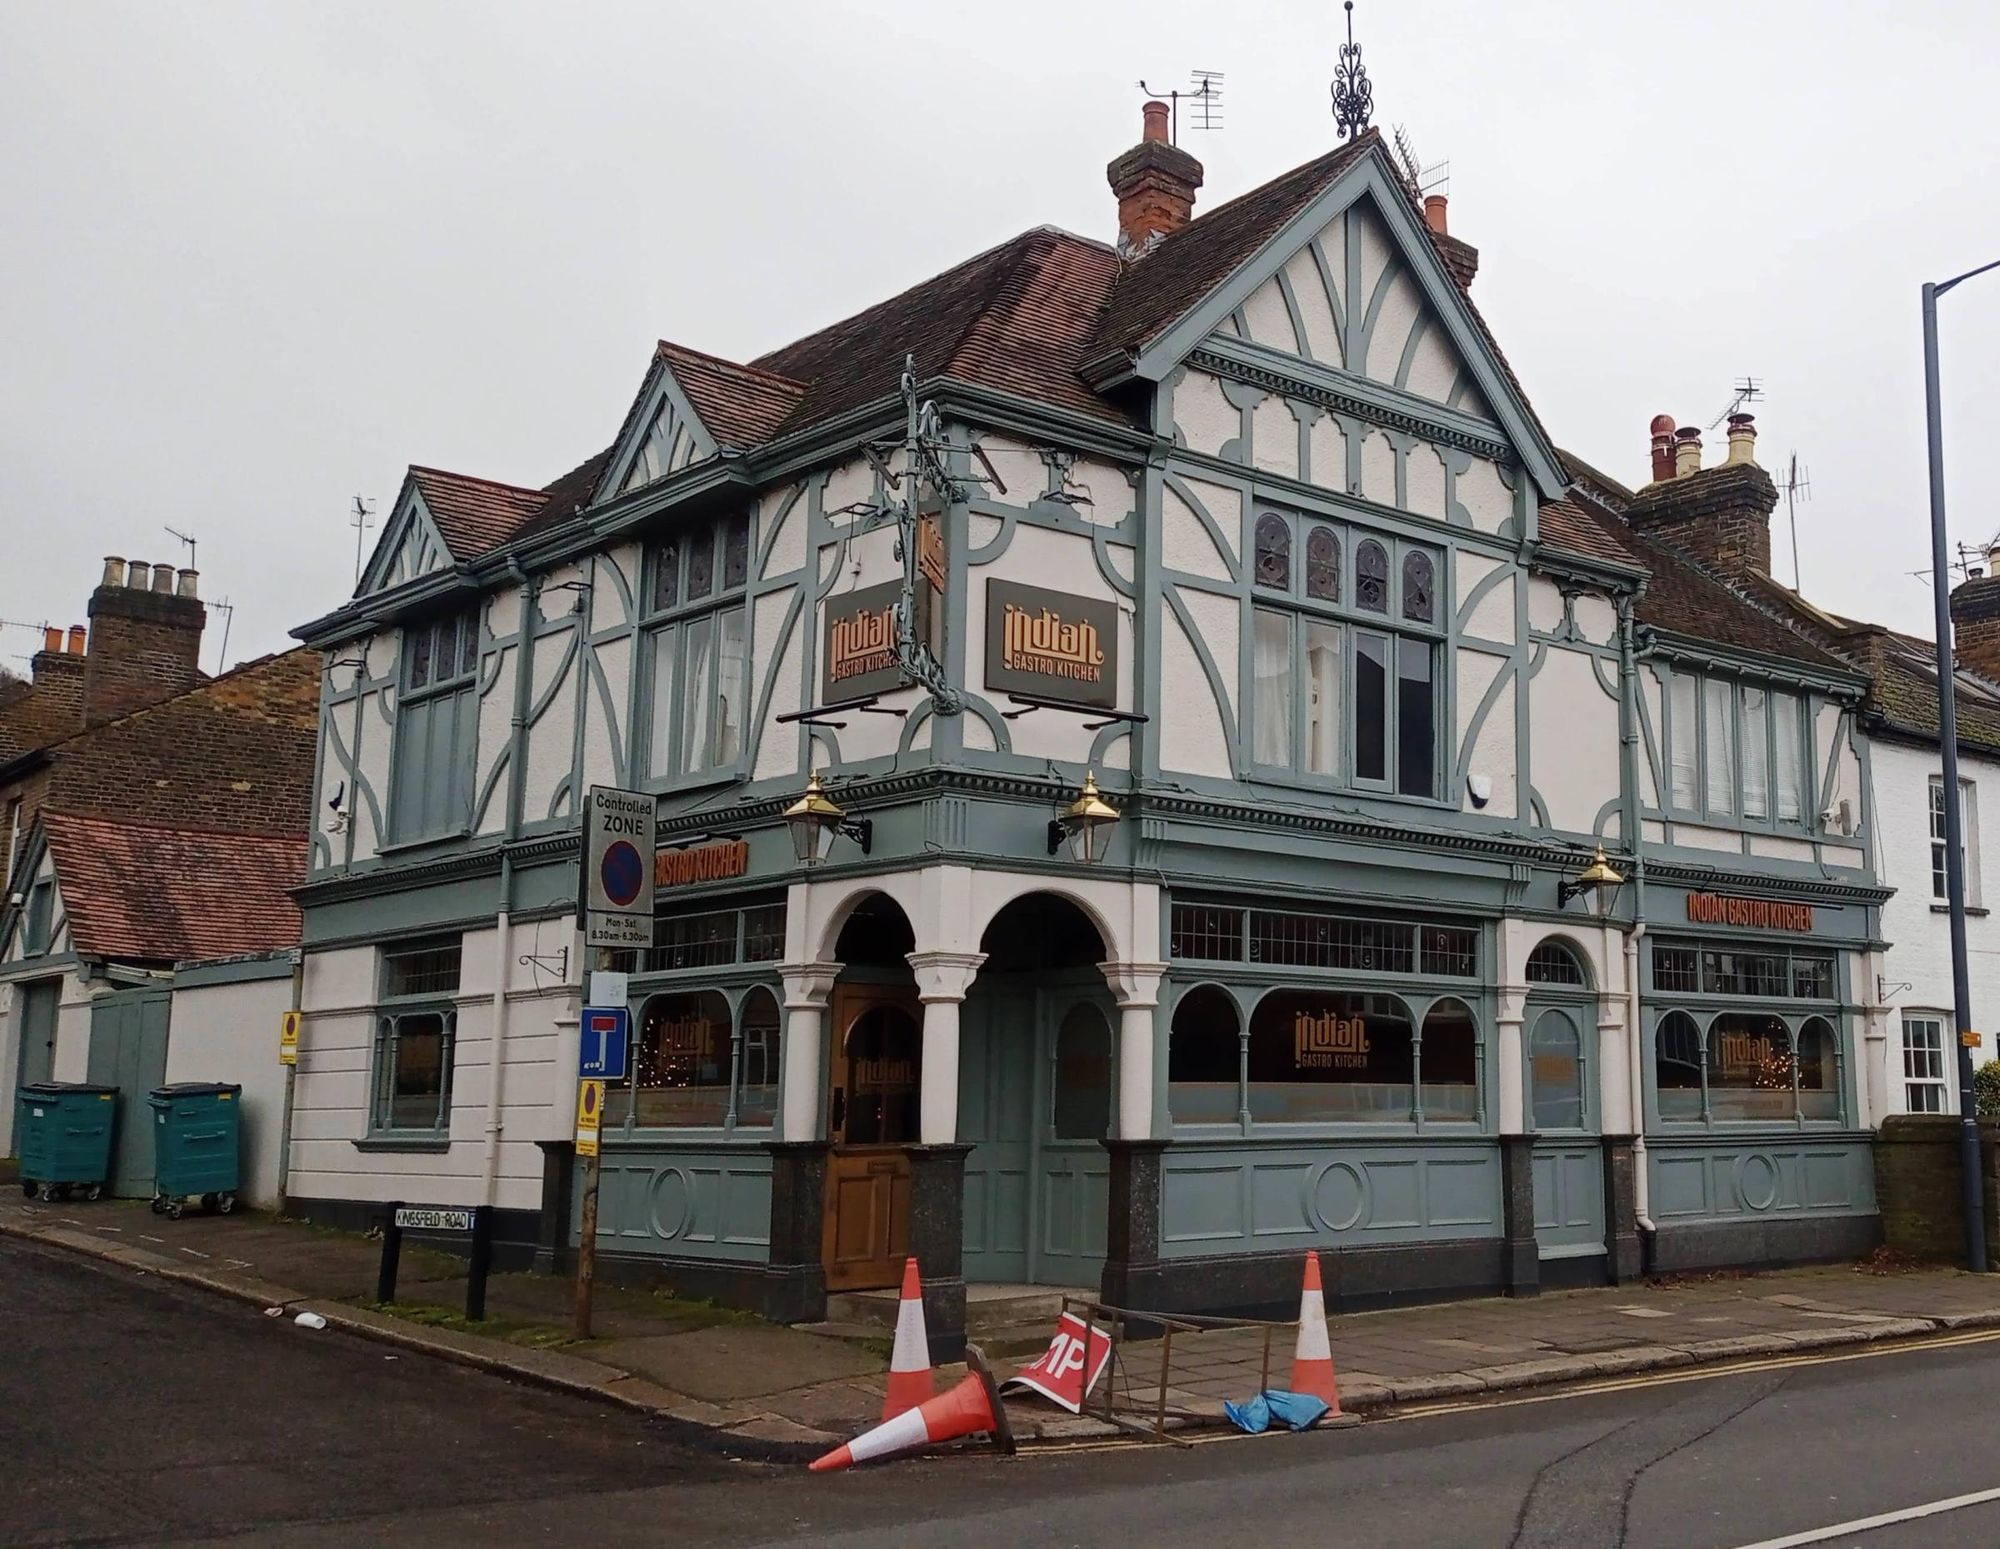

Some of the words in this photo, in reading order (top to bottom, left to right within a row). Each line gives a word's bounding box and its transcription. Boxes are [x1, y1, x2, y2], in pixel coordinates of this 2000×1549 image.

[836, 659, 865, 679] GASTRO
[1013, 653, 1053, 676] GASTRO
[1056, 661, 1100, 682] KITCHEN
[596, 794, 652, 815] Controlled
[603, 814, 643, 836] ZONE
[696, 841, 748, 882] KITCHEN
[1687, 892, 1726, 922] INDIAN
[1728, 899, 1769, 926] GASTRO
[1770, 902, 1812, 931] KITCHEN
[1302, 1053, 1332, 1068] GASTRO
[1334, 1054, 1367, 1069] KITCHEN
[444, 1212, 466, 1228] ROAD
